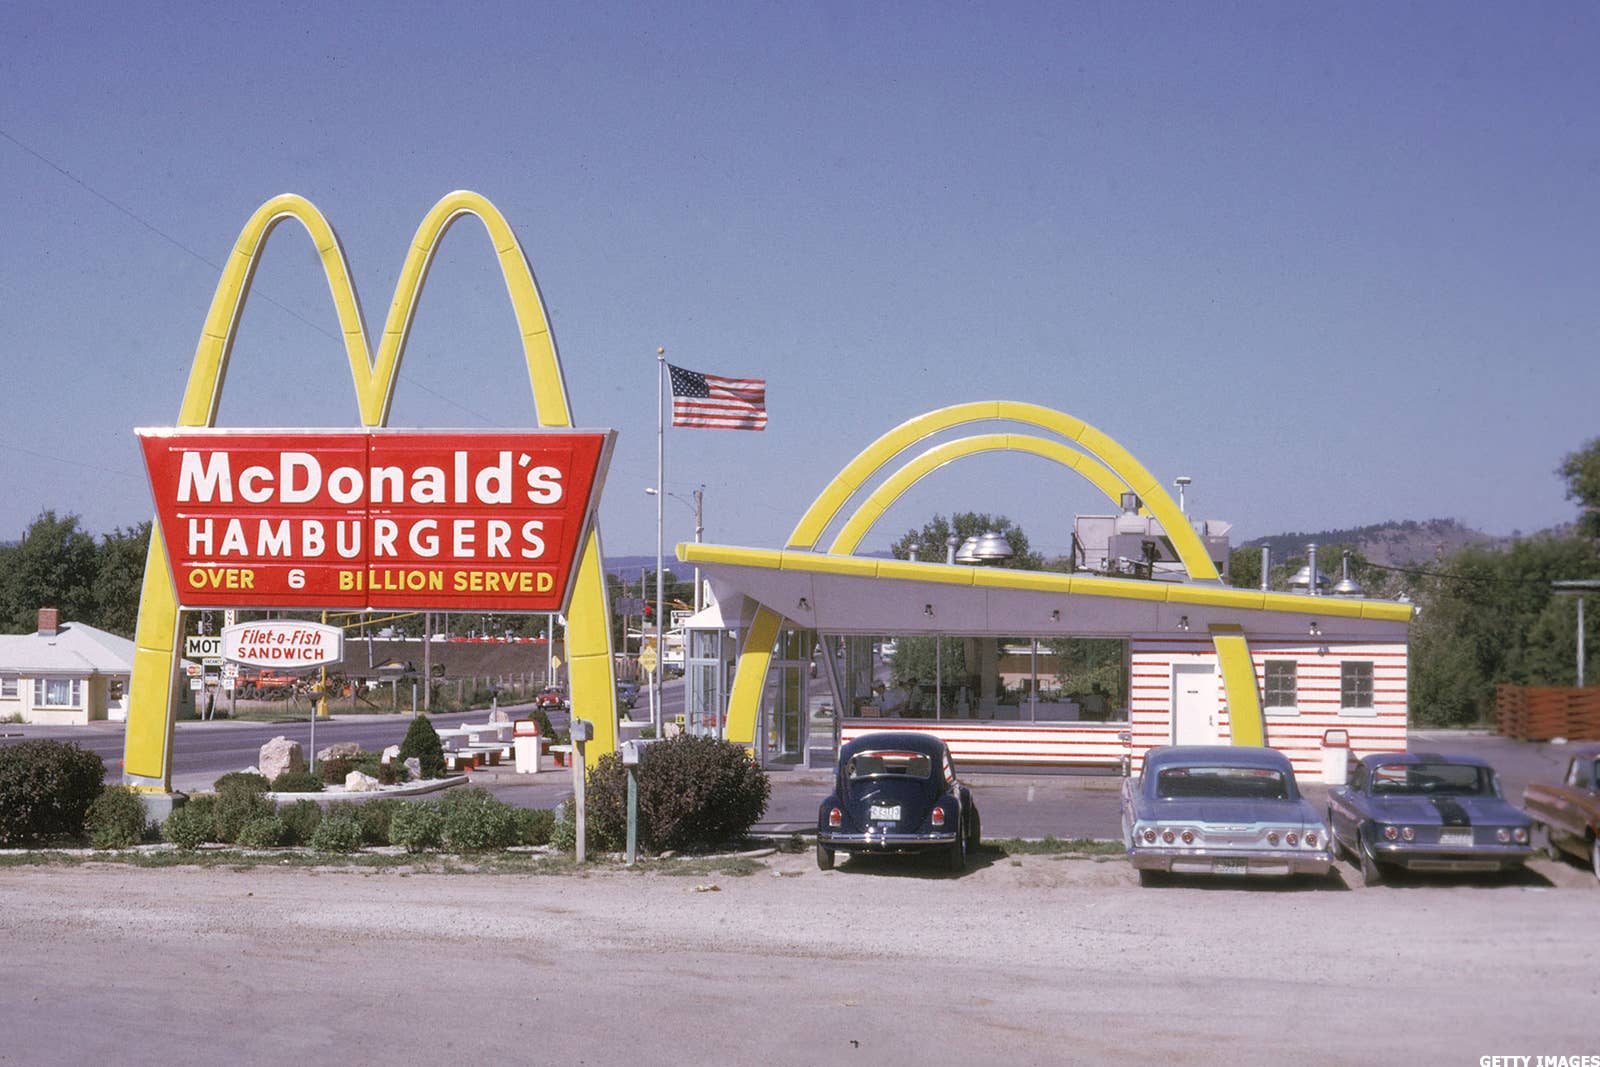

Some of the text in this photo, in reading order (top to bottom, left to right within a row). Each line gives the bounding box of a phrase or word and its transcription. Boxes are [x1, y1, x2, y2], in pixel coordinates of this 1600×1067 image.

[177, 451, 563, 504] McDonald's
[188, 518, 546, 559] HAMBURGERS
[188, 568, 554, 592] OVER 6 BILLION SERVED
[240, 629, 322, 645] Filet-o-Fish
[238, 647, 324, 660] SANDWICH
